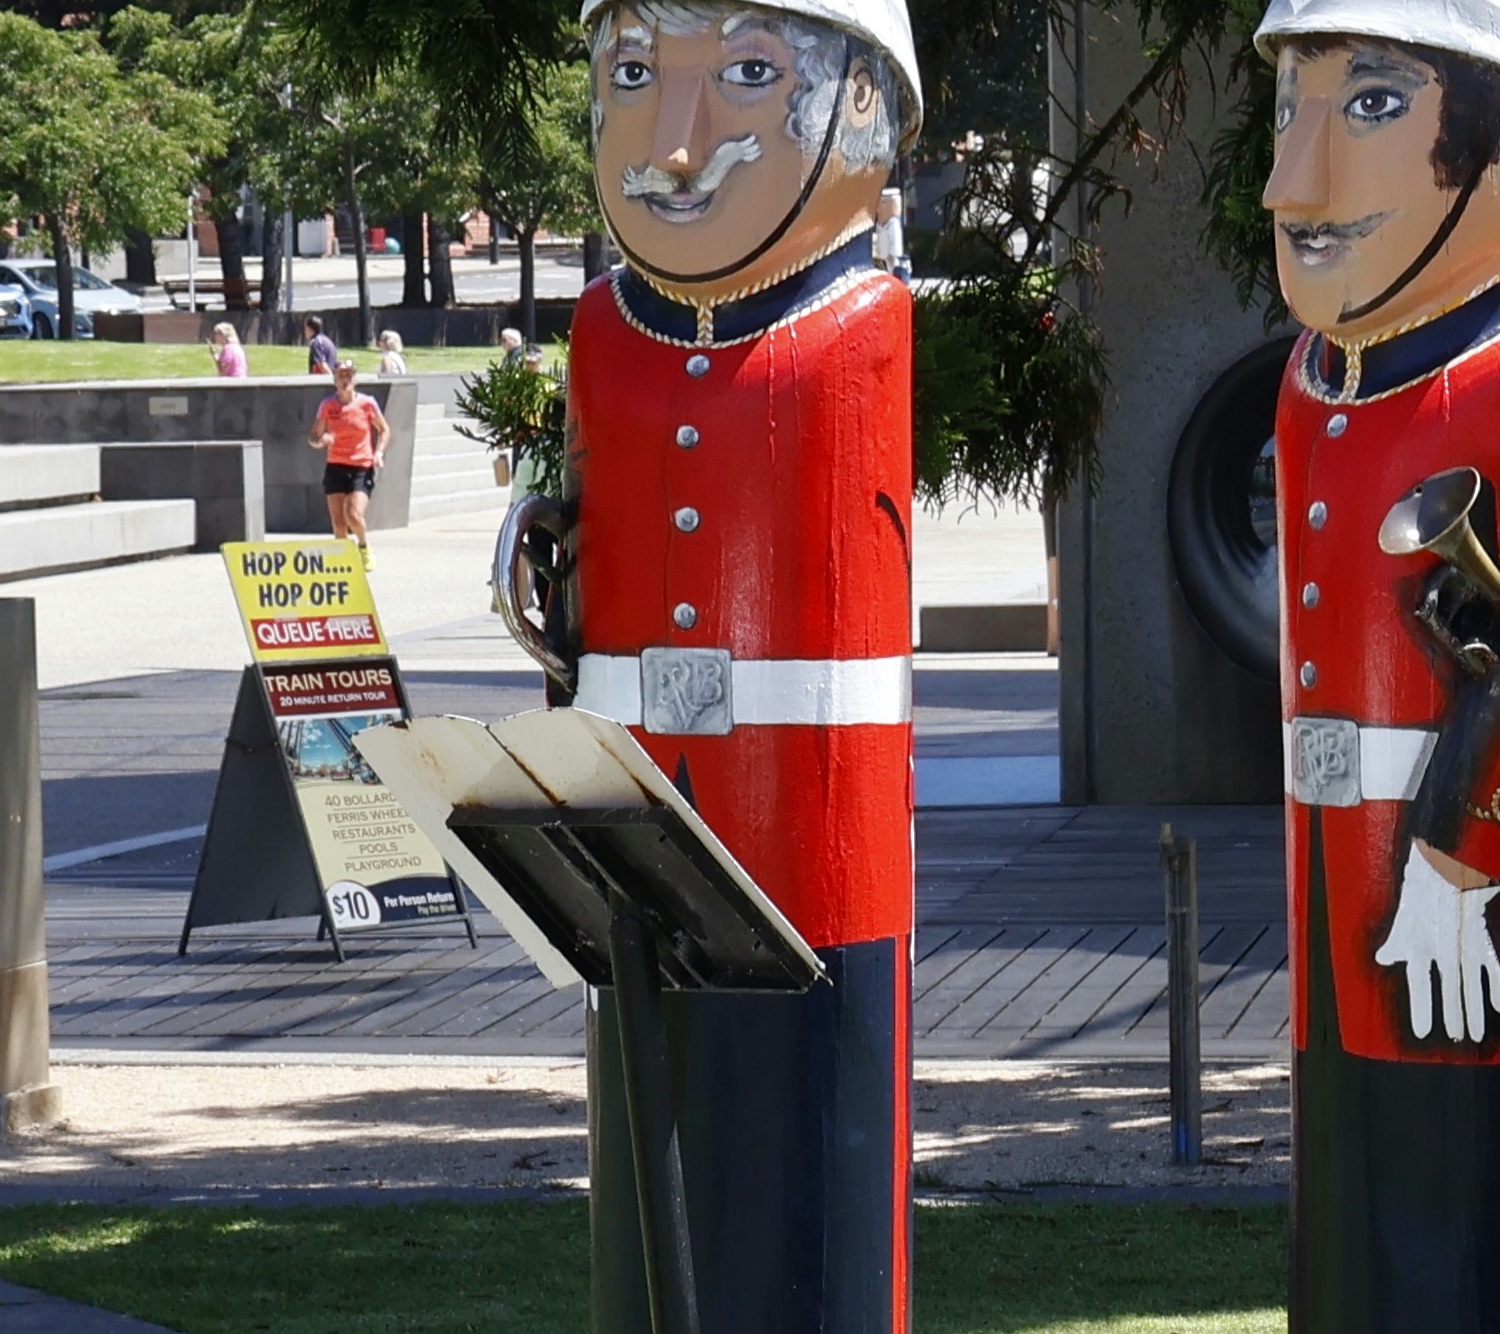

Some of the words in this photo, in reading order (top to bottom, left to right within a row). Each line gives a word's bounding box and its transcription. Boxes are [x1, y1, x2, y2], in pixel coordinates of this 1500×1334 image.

[242, 551, 287, 576] HOP
[258, 583, 303, 608] HOP
[309, 581, 350, 606] OFF
[257, 621, 325, 646] QUEUE
[327, 618, 375, 641] HERE
[264, 672, 324, 693] TRAIN
[325, 669, 392, 689] TOURS
[279, 696, 293, 707] 20
[293, 694, 326, 706] MINUTE
[327, 692, 362, 704] RETURN
[362, 690, 387, 701] TOUR
[325, 794, 341, 807] 40
[326, 811, 369, 824] FERRIS
[332, 824, 416, 840] RESTAURANTS
[359, 842, 398, 854] POOLS
[344, 856, 422, 872] PLAYGROUND
[332, 891, 370, 920] $10
[383, 896, 398, 908] Per
[398, 894, 426, 907] Person
[426, 892, 455, 904] Return
